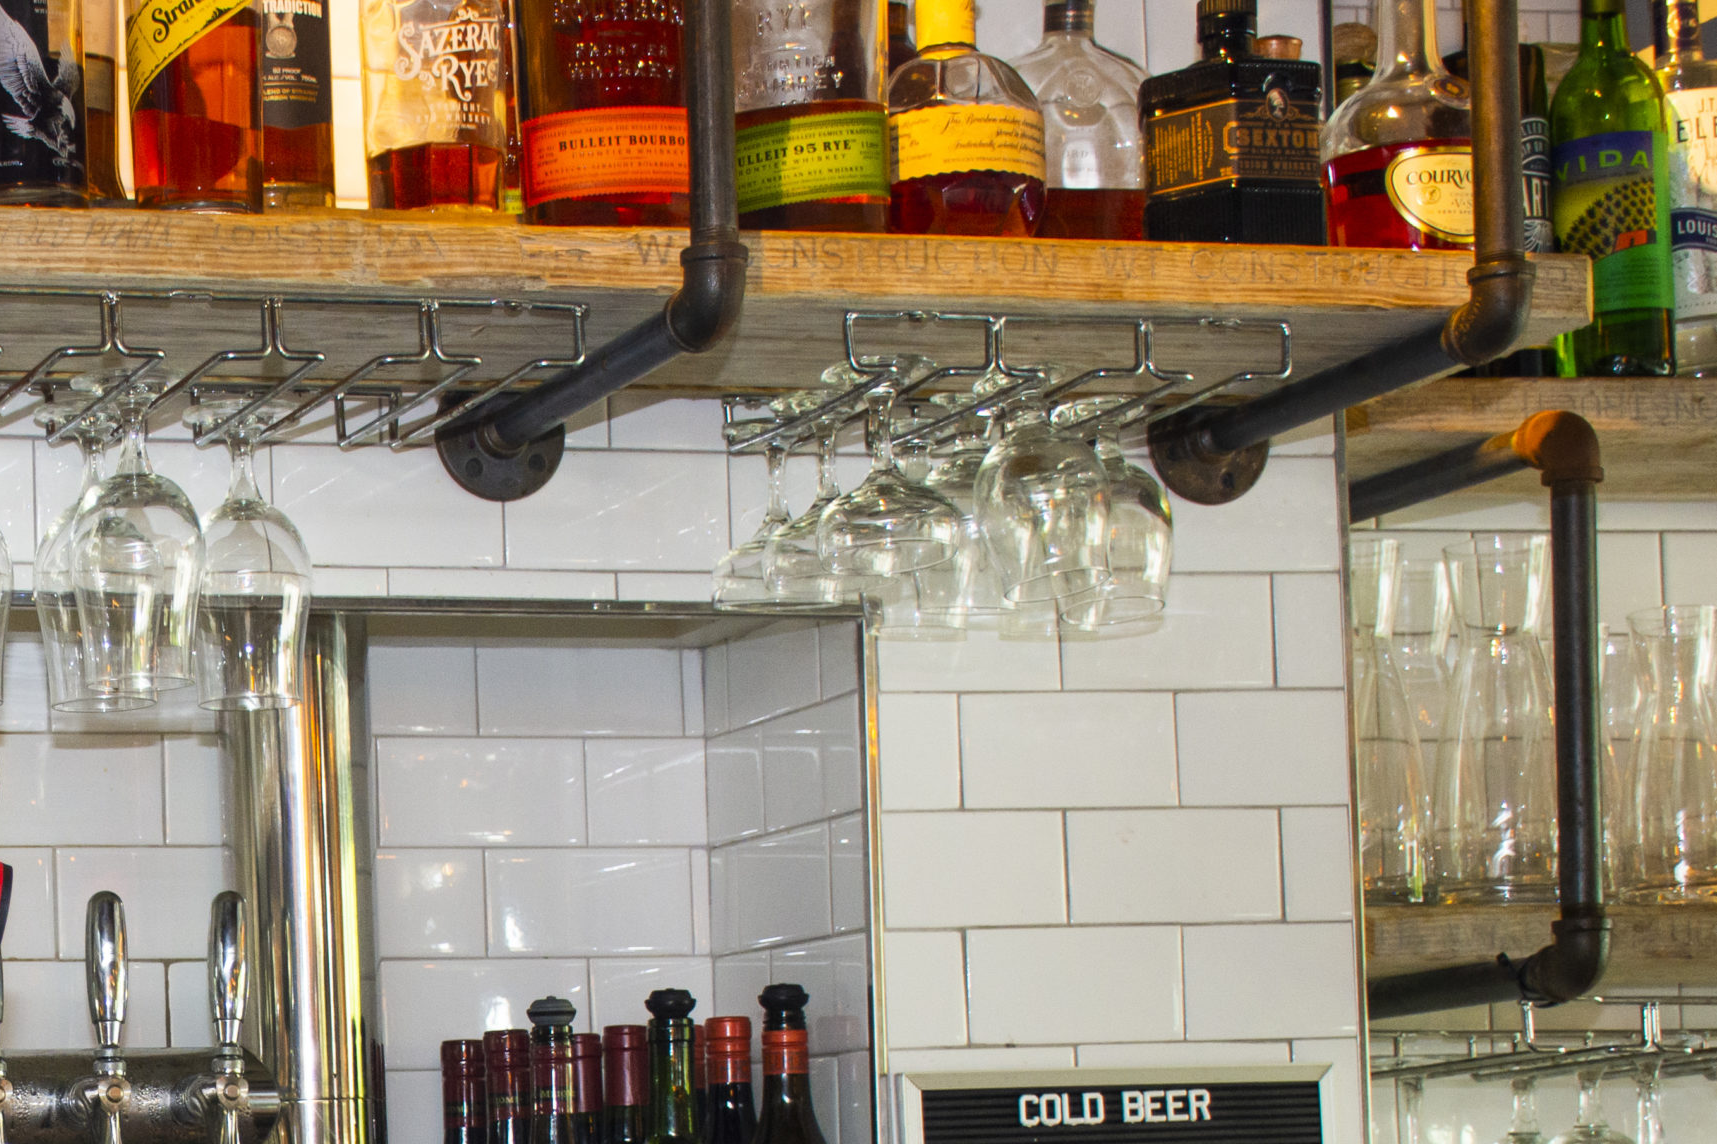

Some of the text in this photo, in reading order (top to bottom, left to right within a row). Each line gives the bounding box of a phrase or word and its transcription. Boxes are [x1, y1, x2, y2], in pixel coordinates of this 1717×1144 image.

[395, 20, 500, 80] SAZERAC
[432, 55, 489, 101] RYE
[559, 136, 621, 152] BULLEIT
[794, 143, 817, 156] 95
[1237, 127, 1318, 147] SEXTON
[1556, 150, 1649, 182] VIDA
[1019, 1088, 1212, 1126] COLD BEER
